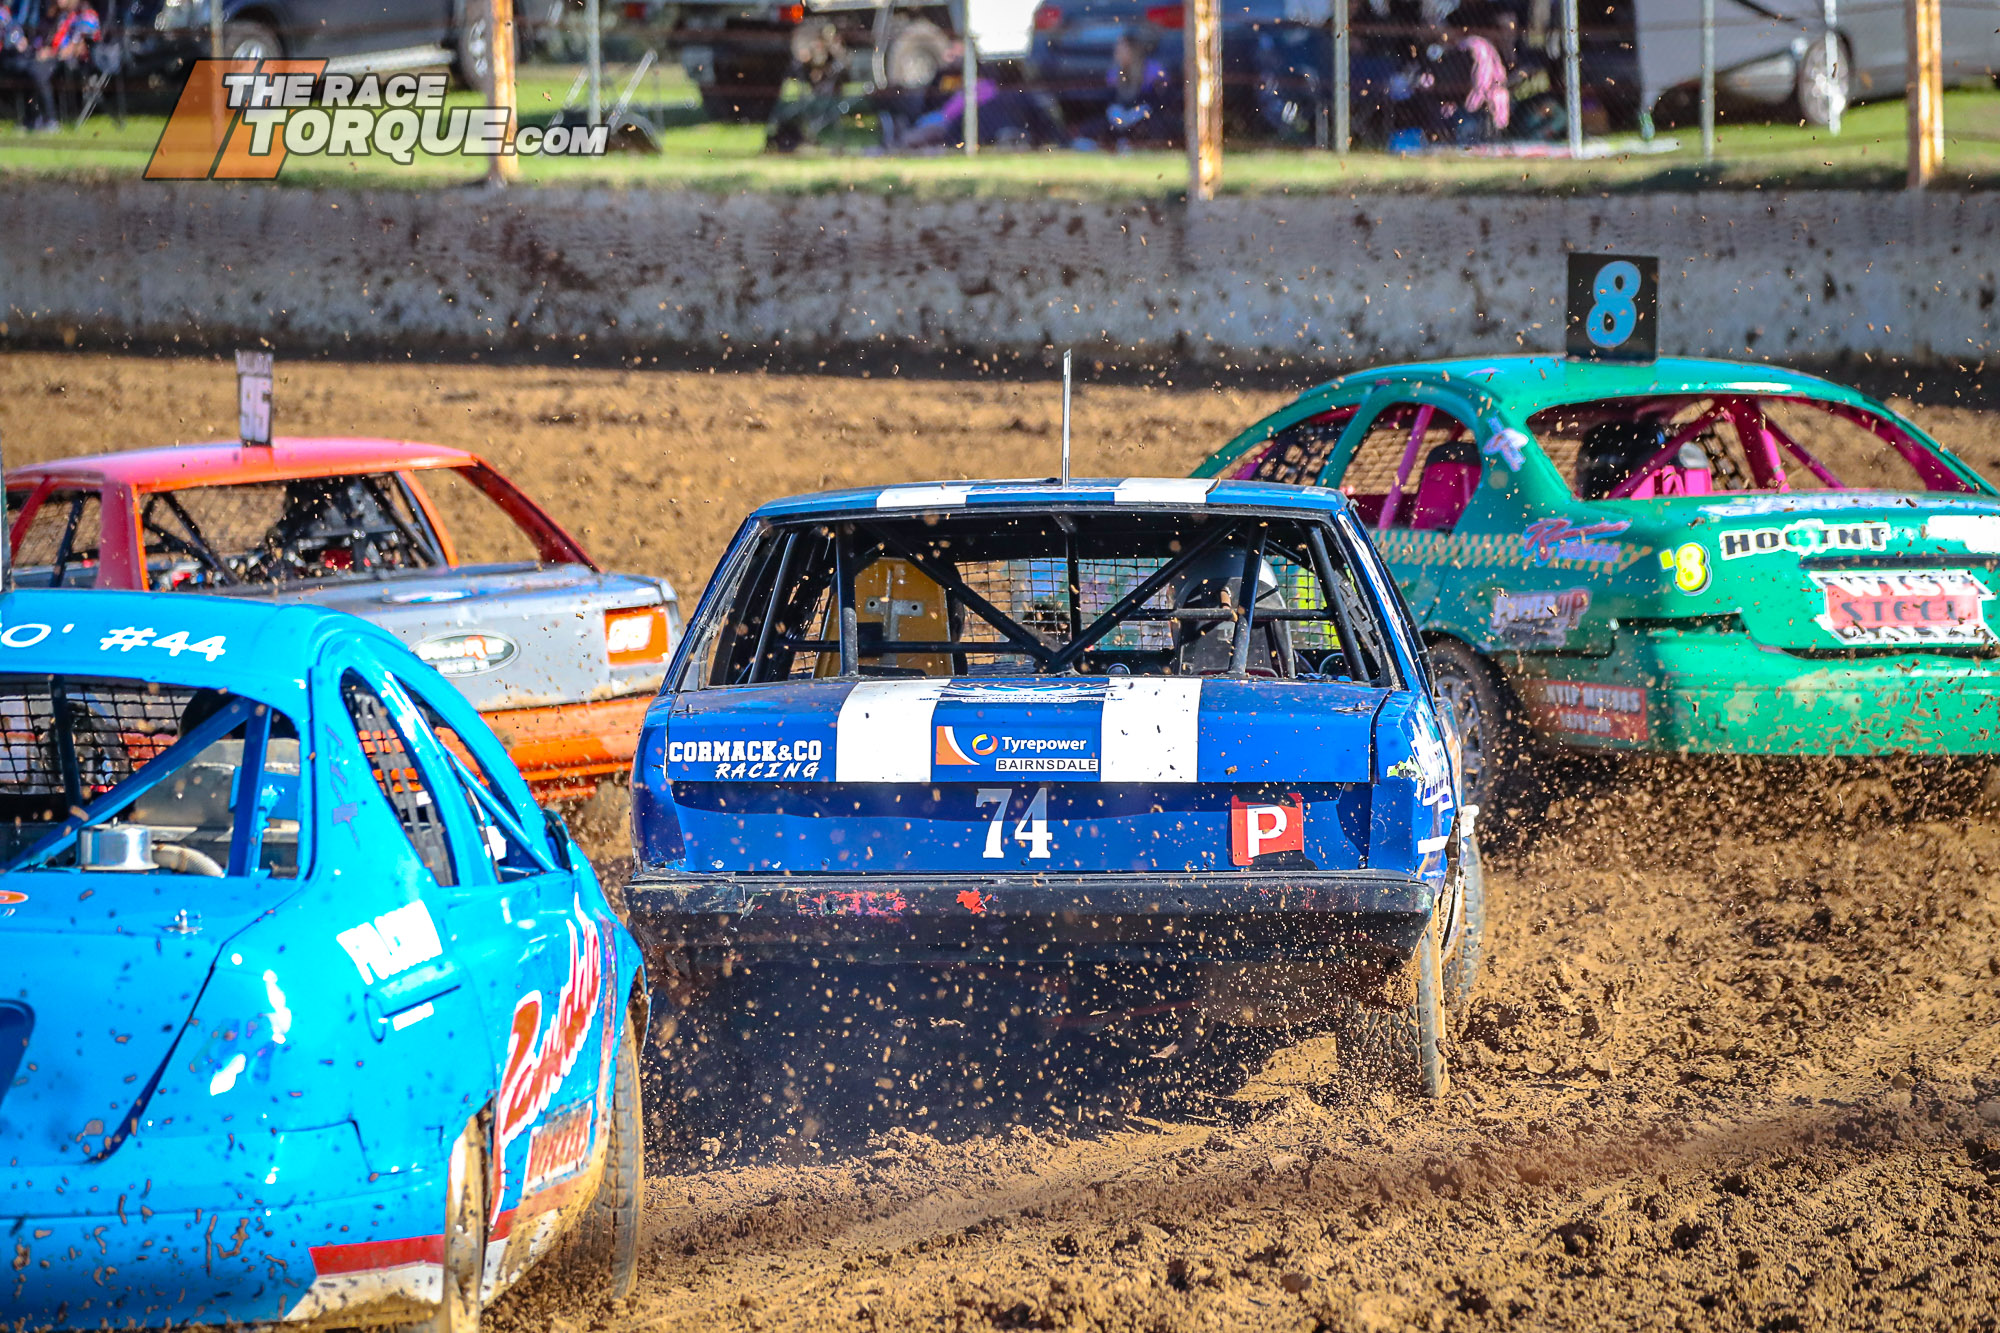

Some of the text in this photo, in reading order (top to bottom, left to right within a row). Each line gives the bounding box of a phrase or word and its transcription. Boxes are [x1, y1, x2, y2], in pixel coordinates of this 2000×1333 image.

[1586, 261, 1641, 348] 8
[100, 626, 226, 662] #44
[668, 739, 822, 763] CORMACK&CO
[1001, 735, 1088, 754] Tyrepower
[715, 761, 819, 780] RACING
[997, 758, 1097, 771] BAIRNSDALE
[975, 787, 1053, 859] 74
[1246, 804, 1287, 859] P
